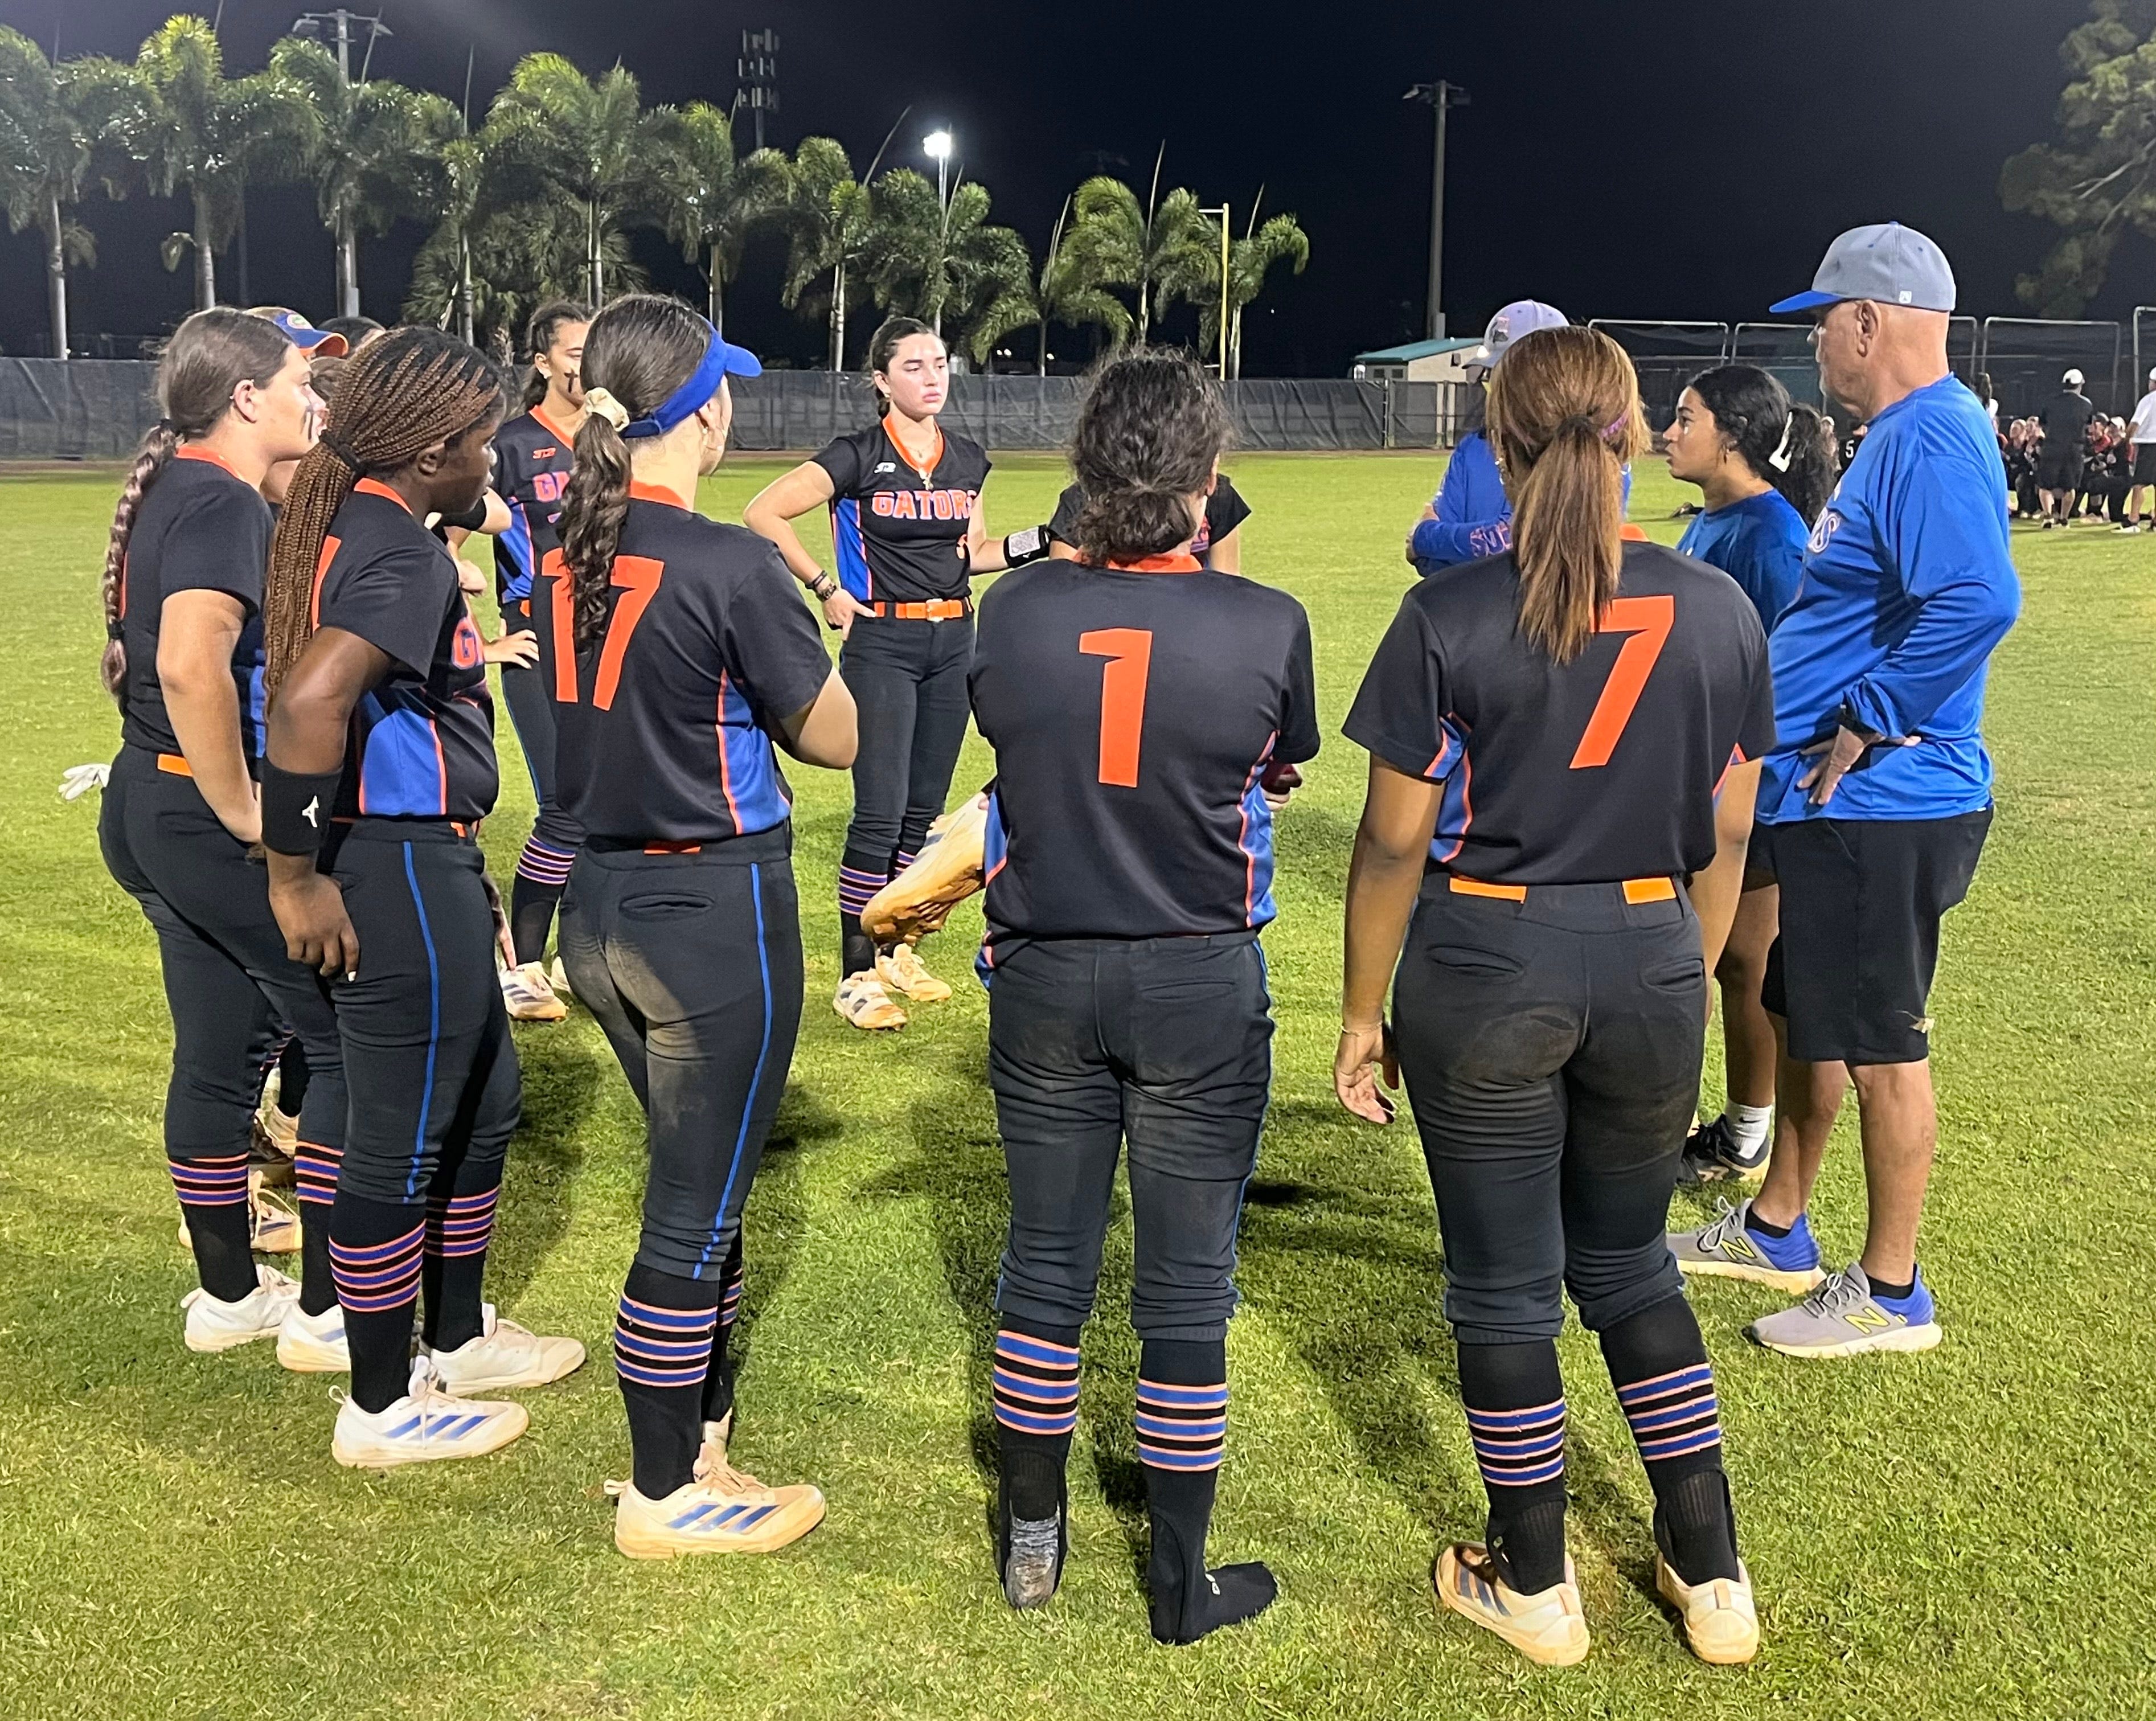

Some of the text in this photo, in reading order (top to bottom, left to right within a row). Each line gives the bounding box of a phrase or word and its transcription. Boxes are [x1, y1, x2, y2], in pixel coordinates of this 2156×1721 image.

[1845, 439, 1855, 458] 5
[542, 547, 665, 711] 17
[1079, 628, 1153, 788] 1
[1569, 595, 1675, 769] 7
[1844, 1307, 1891, 1335] N
